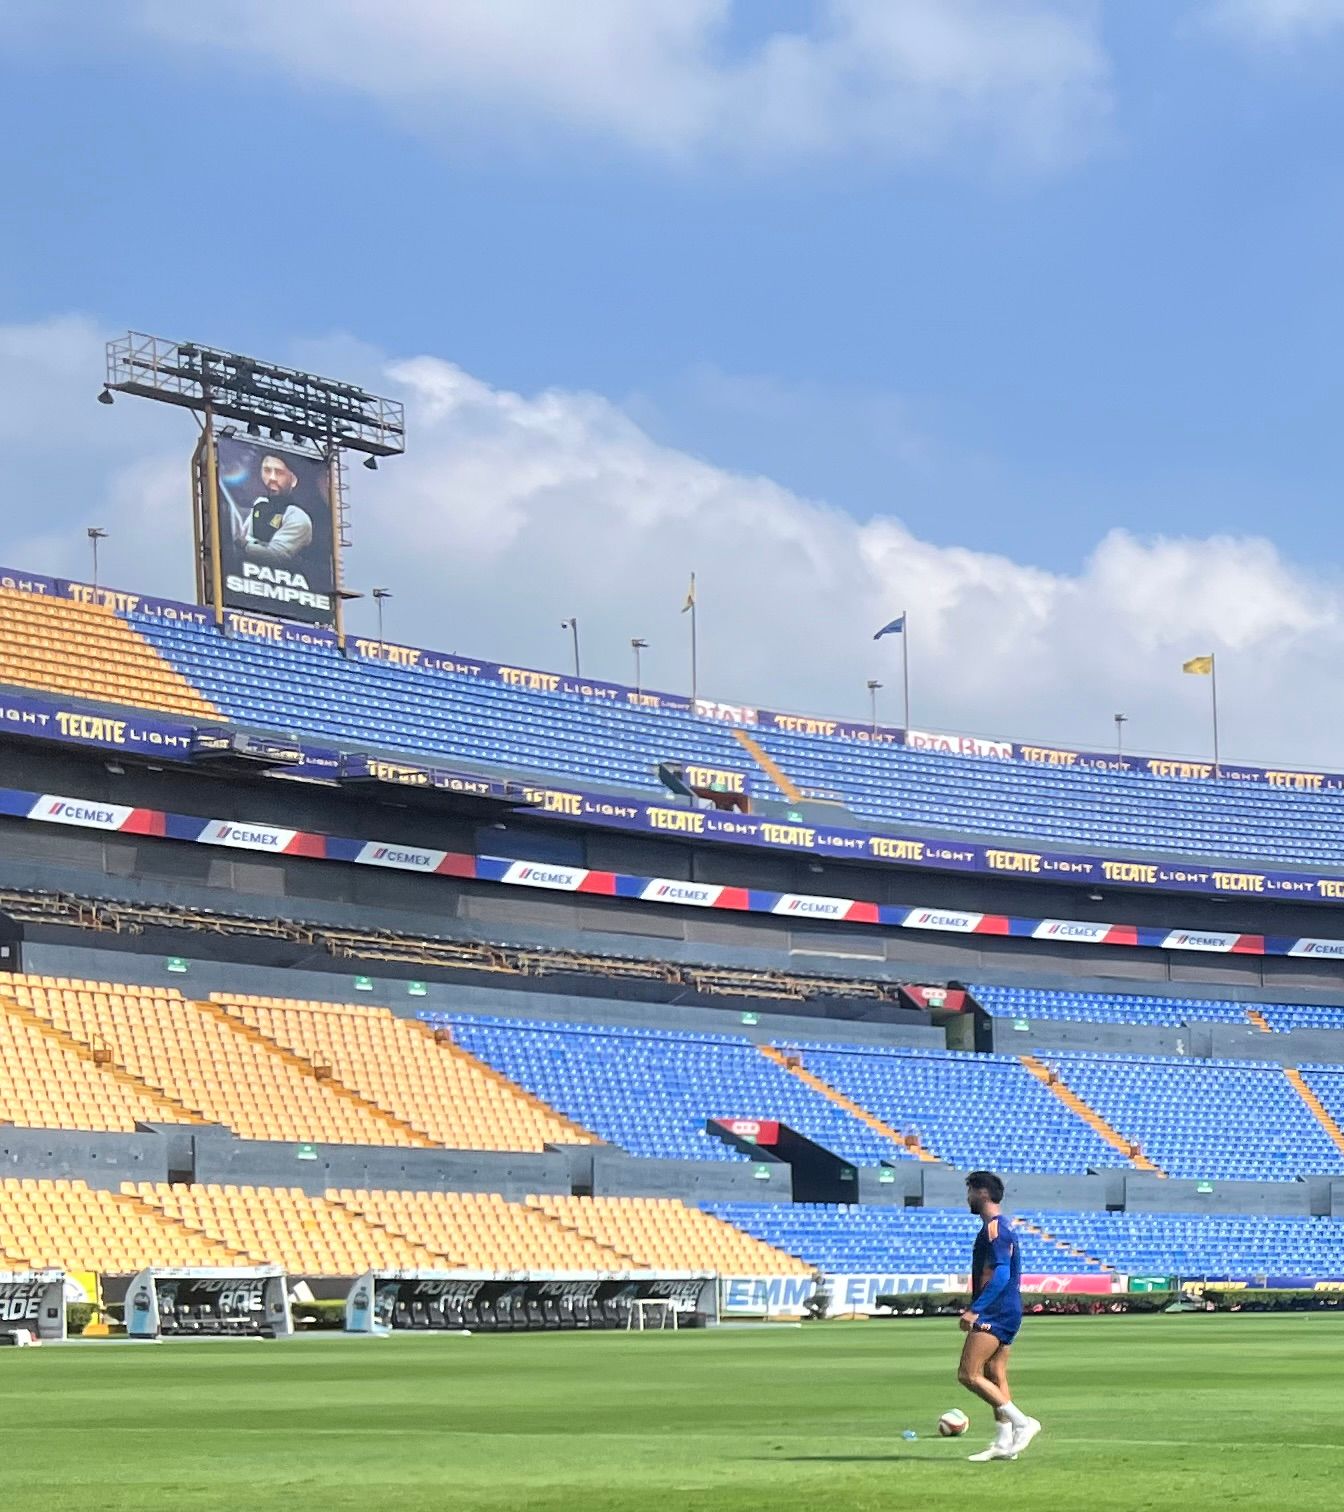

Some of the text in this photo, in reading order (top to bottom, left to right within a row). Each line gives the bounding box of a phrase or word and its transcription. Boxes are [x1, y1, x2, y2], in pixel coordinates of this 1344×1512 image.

[242, 562, 309, 590] PARA
[226, 575, 331, 610] SIEMPRE
[68, 583, 206, 624] TECATE LIGHT
[229, 614, 335, 648] TECATE LIGHT
[355, 640, 481, 676] TECATE LIGHT
[498, 667, 618, 700] TECATE LIGHT
[0, 711, 50, 727] IGHT
[56, 711, 128, 744] TECATE
[130, 729, 191, 748] LIGHT
[775, 716, 895, 743] TECATE LIGHT
[1021, 746, 1131, 771] TECATE LIGHT
[685, 766, 745, 792] TECATE
[1148, 760, 1259, 782] TECATE LIGHT
[1265, 771, 1325, 789] TECATE
[522, 787, 638, 818] TECATE LIGHT
[65, 807, 114, 824] CEMEX
[646, 807, 757, 836] TECATE LIGHT
[232, 830, 278, 846] CEMEX
[760, 822, 865, 849] TECATE LIGHT
[387, 851, 431, 867] CEMEX
[869, 837, 974, 862] TECATE LIGHT
[986, 850, 1093, 873] TECATE LIGHT
[1102, 861, 1208, 883] TECATE LIGHT
[532, 871, 573, 885] CEMEX
[1212, 872, 1314, 892] TECATE LIGHT
[669, 887, 709, 901] CEMEX
[800, 902, 839, 914] CEMEX
[931, 914, 969, 928] CEMEX
[1060, 926, 1098, 937] CEMEX
[1188, 935, 1226, 946] CEMEX
[0, 1282, 46, 1298] WER
[191, 1279, 268, 1293] POWER
[414, 1281, 485, 1297] POWER
[538, 1281, 602, 1296] POWER
[648, 1281, 704, 1296] POWER
